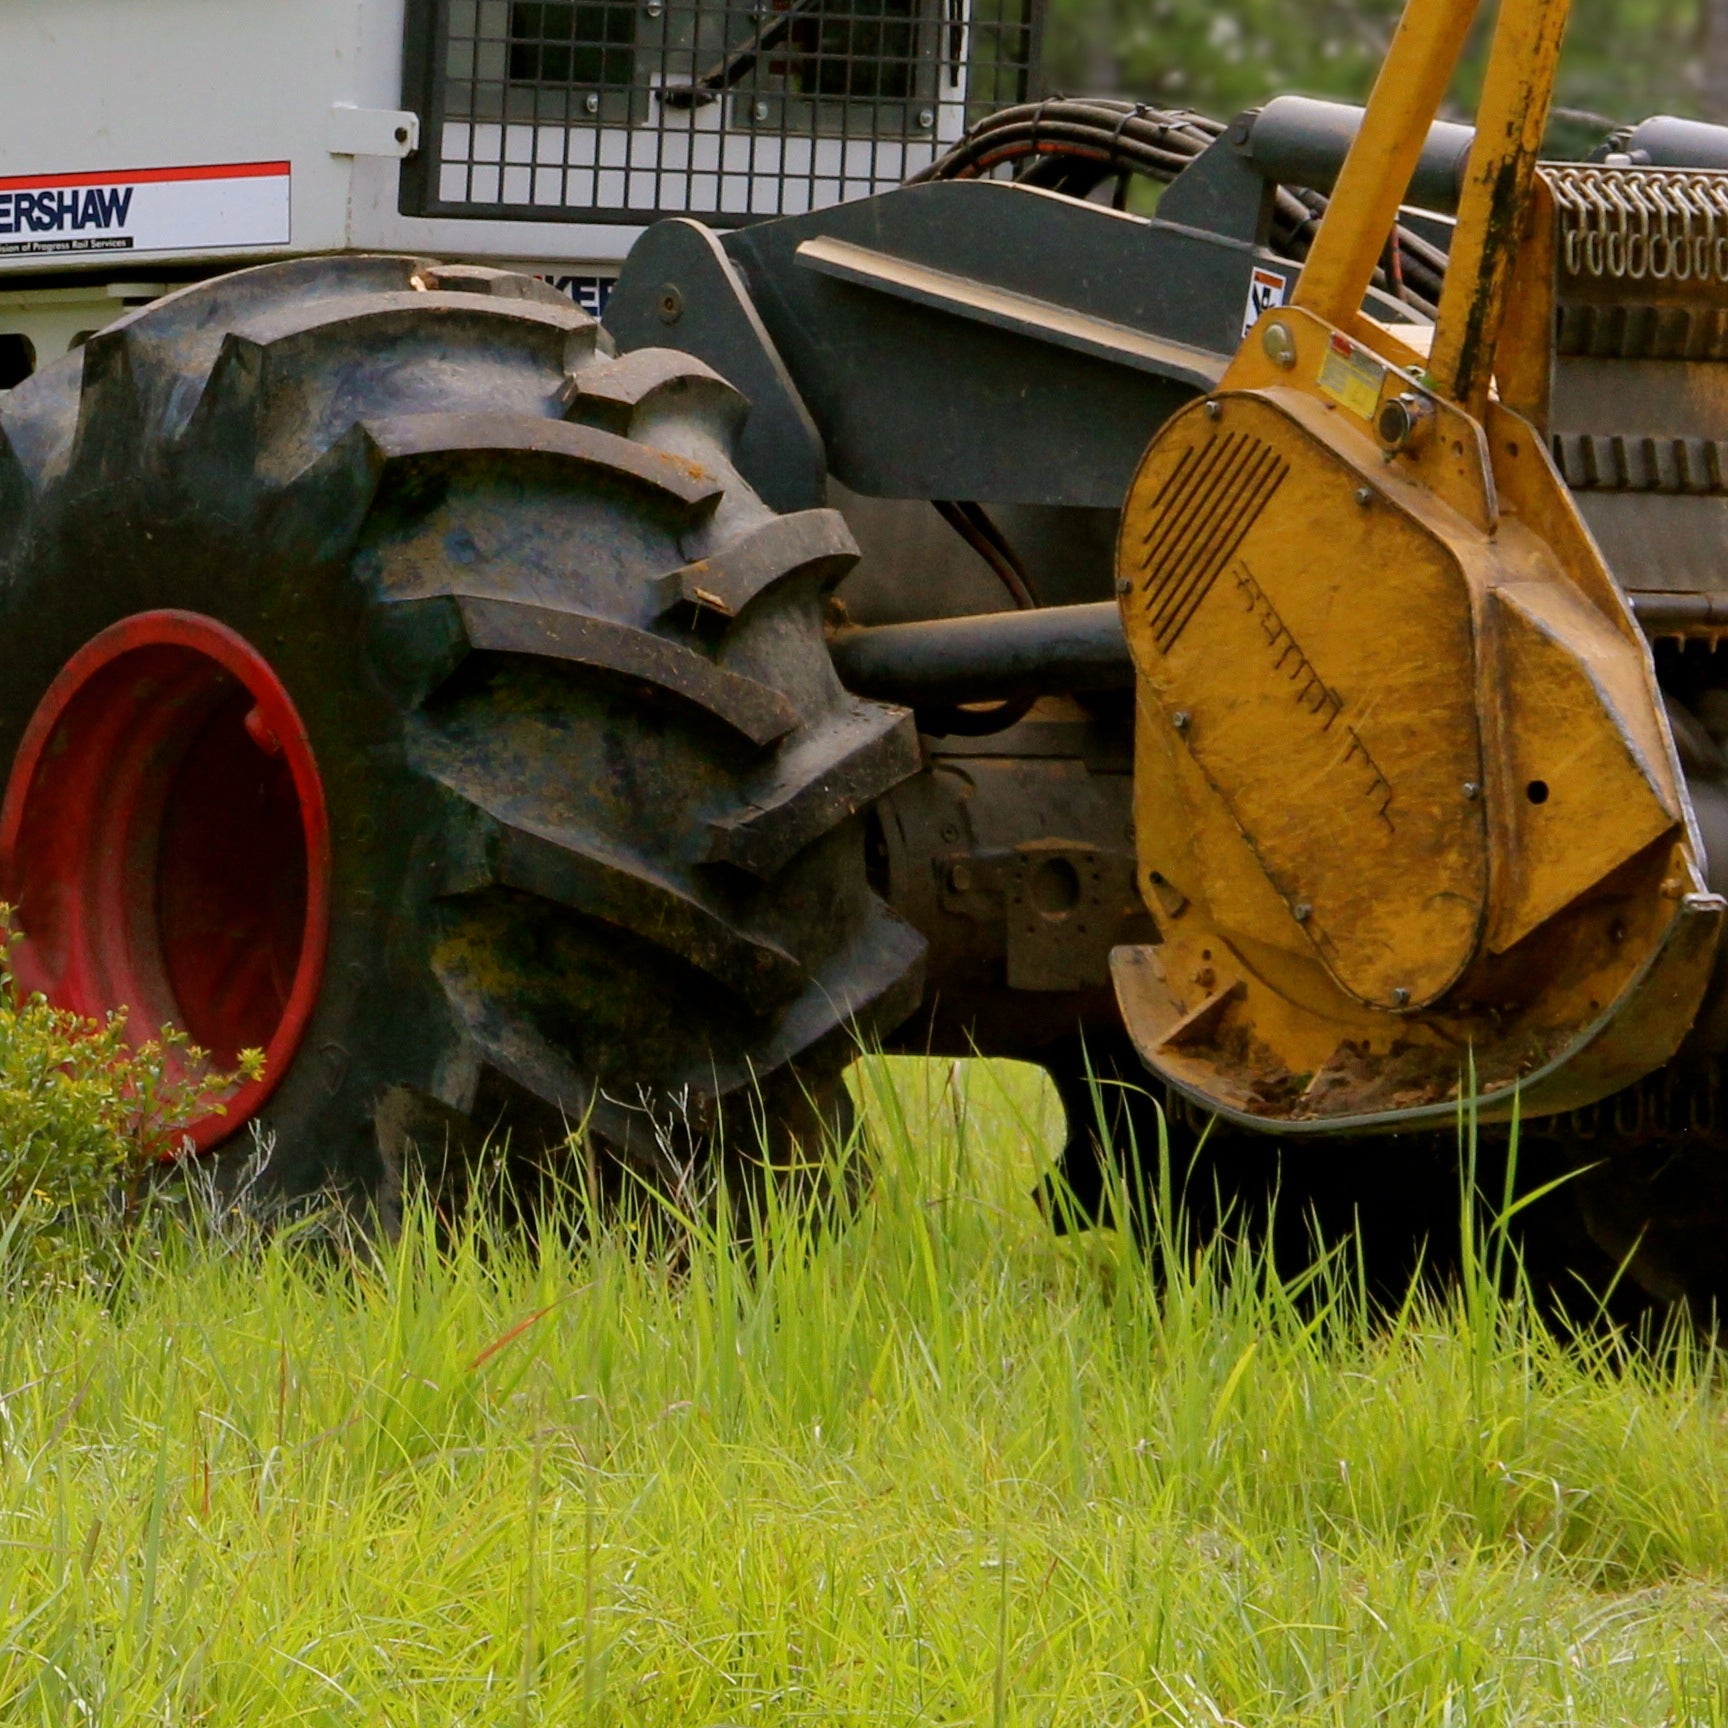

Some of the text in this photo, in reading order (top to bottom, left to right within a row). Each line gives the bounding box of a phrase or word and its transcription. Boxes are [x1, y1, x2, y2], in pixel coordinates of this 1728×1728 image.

[22, 243, 31, 252] of
[33, 241, 70, 252] Progress
[72, 240, 88, 249] Rail
[90, 239, 127, 249] Services
